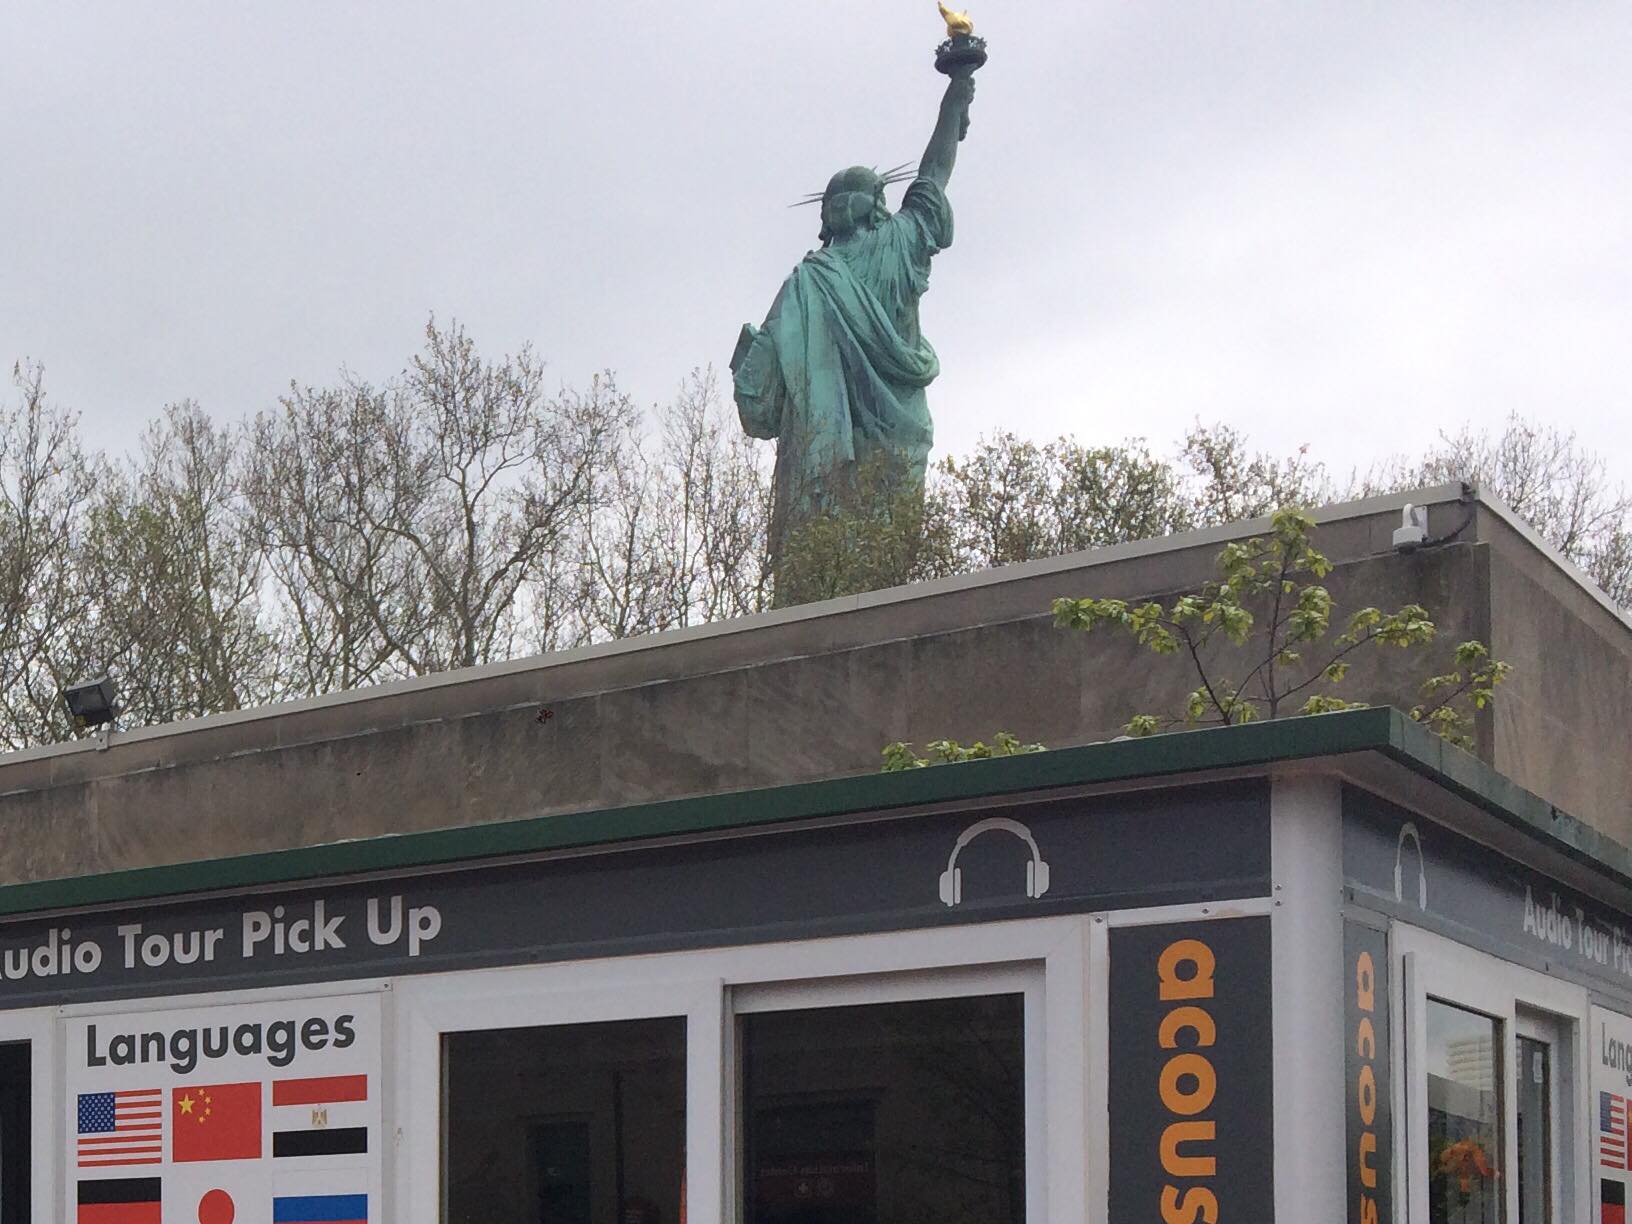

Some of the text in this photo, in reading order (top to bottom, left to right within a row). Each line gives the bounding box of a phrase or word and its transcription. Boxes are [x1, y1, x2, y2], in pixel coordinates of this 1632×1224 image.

[119, 924, 223, 969] Tour
[242, 912, 346, 958] Pick
[367, 906, 441, 957] Up
[1522, 885, 1573, 950] Audio
[1575, 908, 1610, 965] Tour
[86, 1014, 356, 1075] Languages
